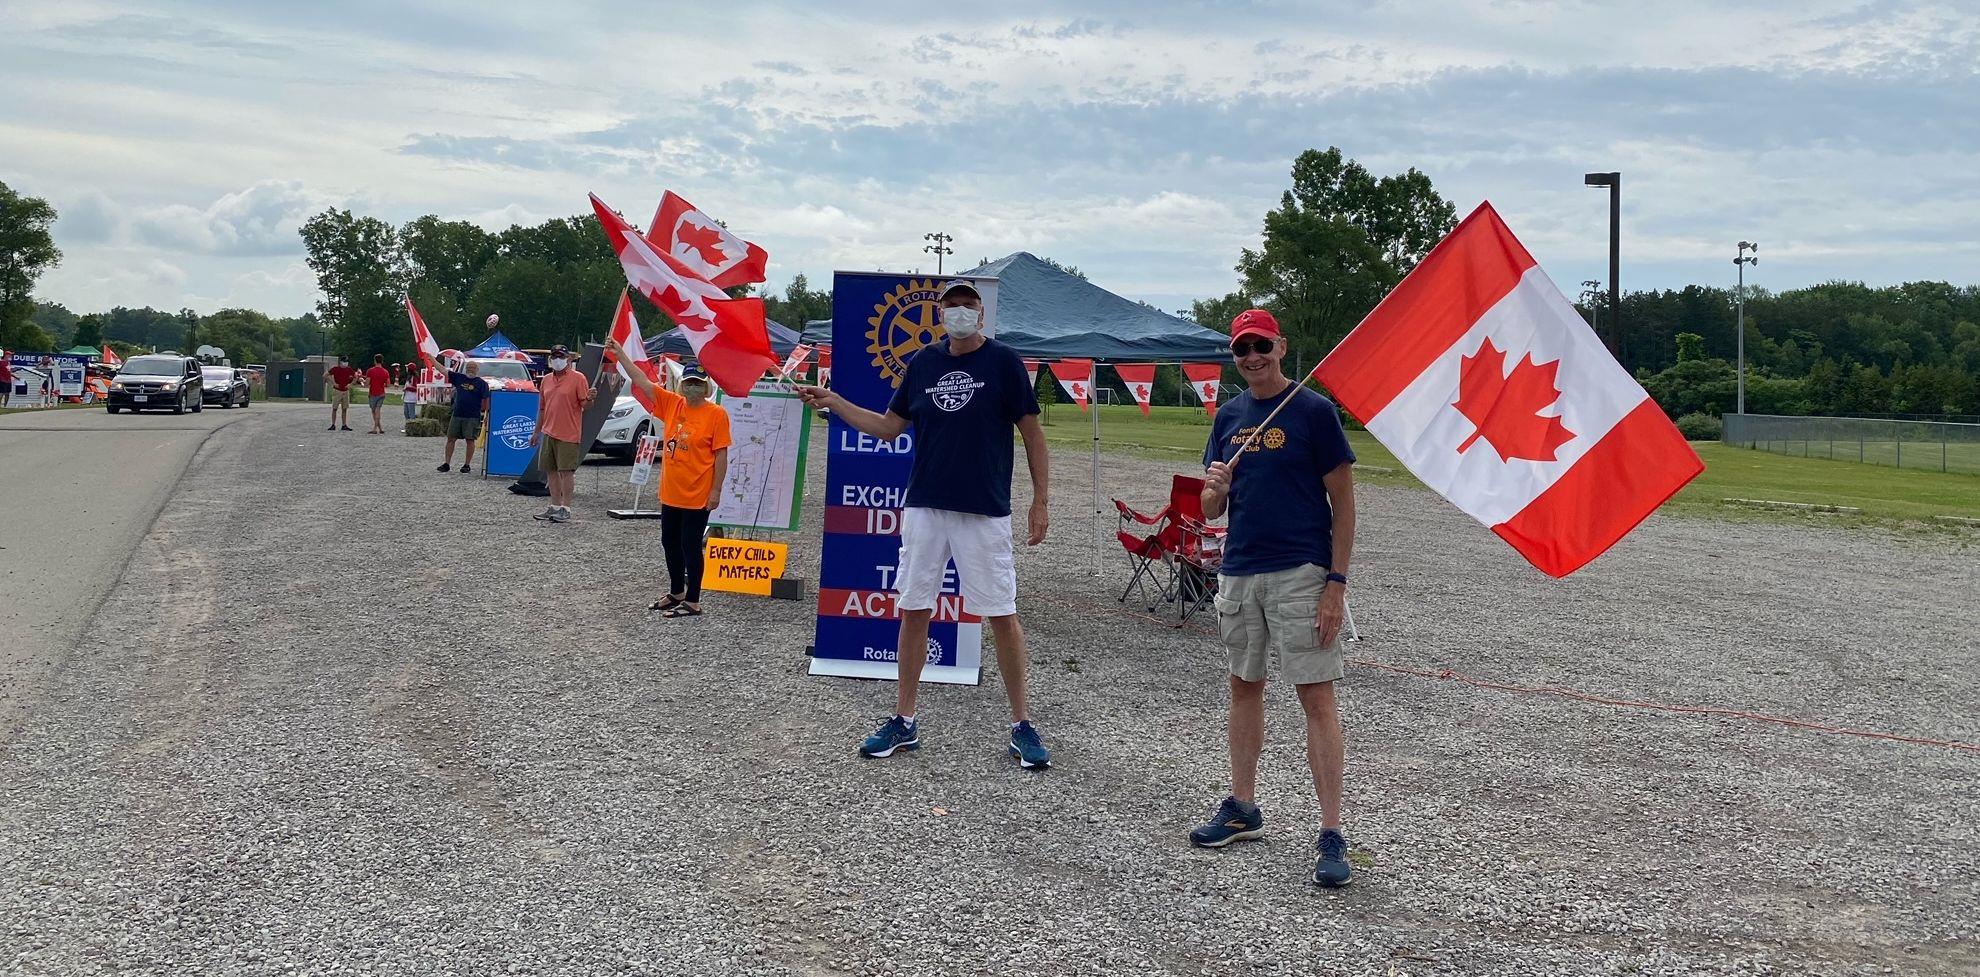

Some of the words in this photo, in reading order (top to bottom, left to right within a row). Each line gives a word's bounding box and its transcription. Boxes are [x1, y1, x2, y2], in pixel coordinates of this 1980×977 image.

[13, 354, 36, 362] DUBE
[37, 355, 78, 364] RALTORS
[955, 377, 974, 385] LAKES
[925, 385, 958, 394] WATERSHED
[959, 381, 985, 390] CLEANUP
[519, 420, 536, 428] LAKES
[492, 428, 523, 436] WATERSHED
[1238, 425, 1263, 434] Fonth
[1230, 435, 1262, 445] Rotay
[709, 545, 743, 560] EVERY
[744, 547, 776, 561] CHILD
[718, 564, 770, 580] MATTERS
[876, 565, 956, 593] TE
[841, 591, 960, 621] ACTN
